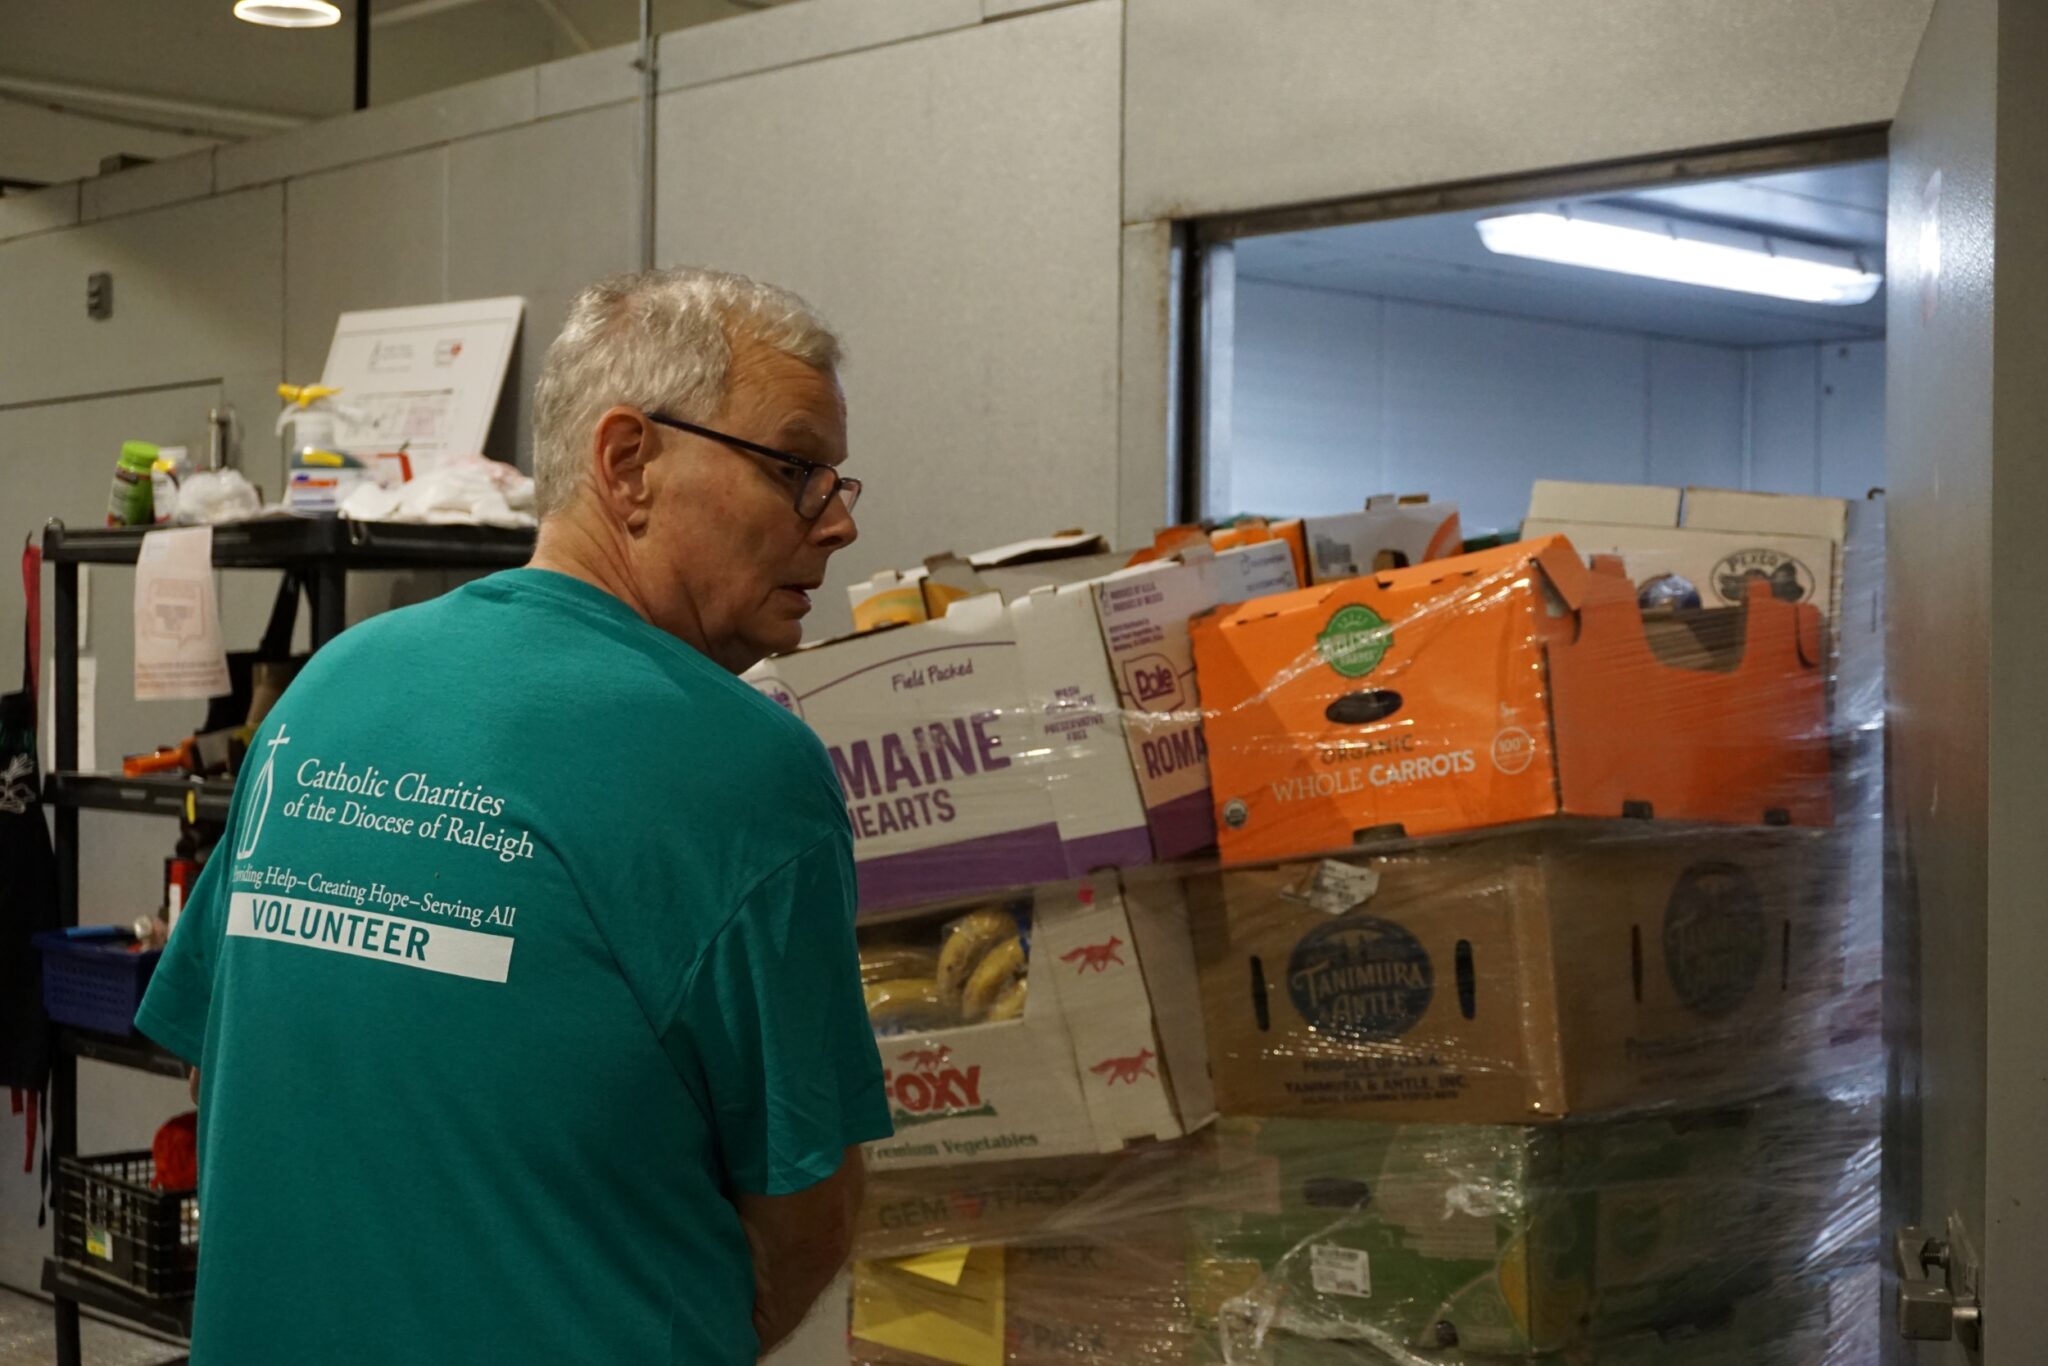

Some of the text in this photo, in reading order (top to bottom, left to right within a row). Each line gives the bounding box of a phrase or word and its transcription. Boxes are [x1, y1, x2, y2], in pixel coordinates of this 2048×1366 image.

[892, 659, 973, 691] Field Packed
[1134, 664, 1175, 698] Dole
[1044, 714, 1104, 735] PRESERVATIVE
[1321, 734, 1413, 765] ORGANIC
[297, 758, 504, 816] Catholic Charities
[1272, 749, 1475, 803] WHOLE CARROTS
[284, 793, 534, 862] of the Diocese of Raleigh
[252, 897, 431, 961] VOLUNTEER
[485, 906, 516, 927] All
[1291, 960, 1426, 1008] TANIMURA
[942, 1132, 1038, 1156] Vegetables
